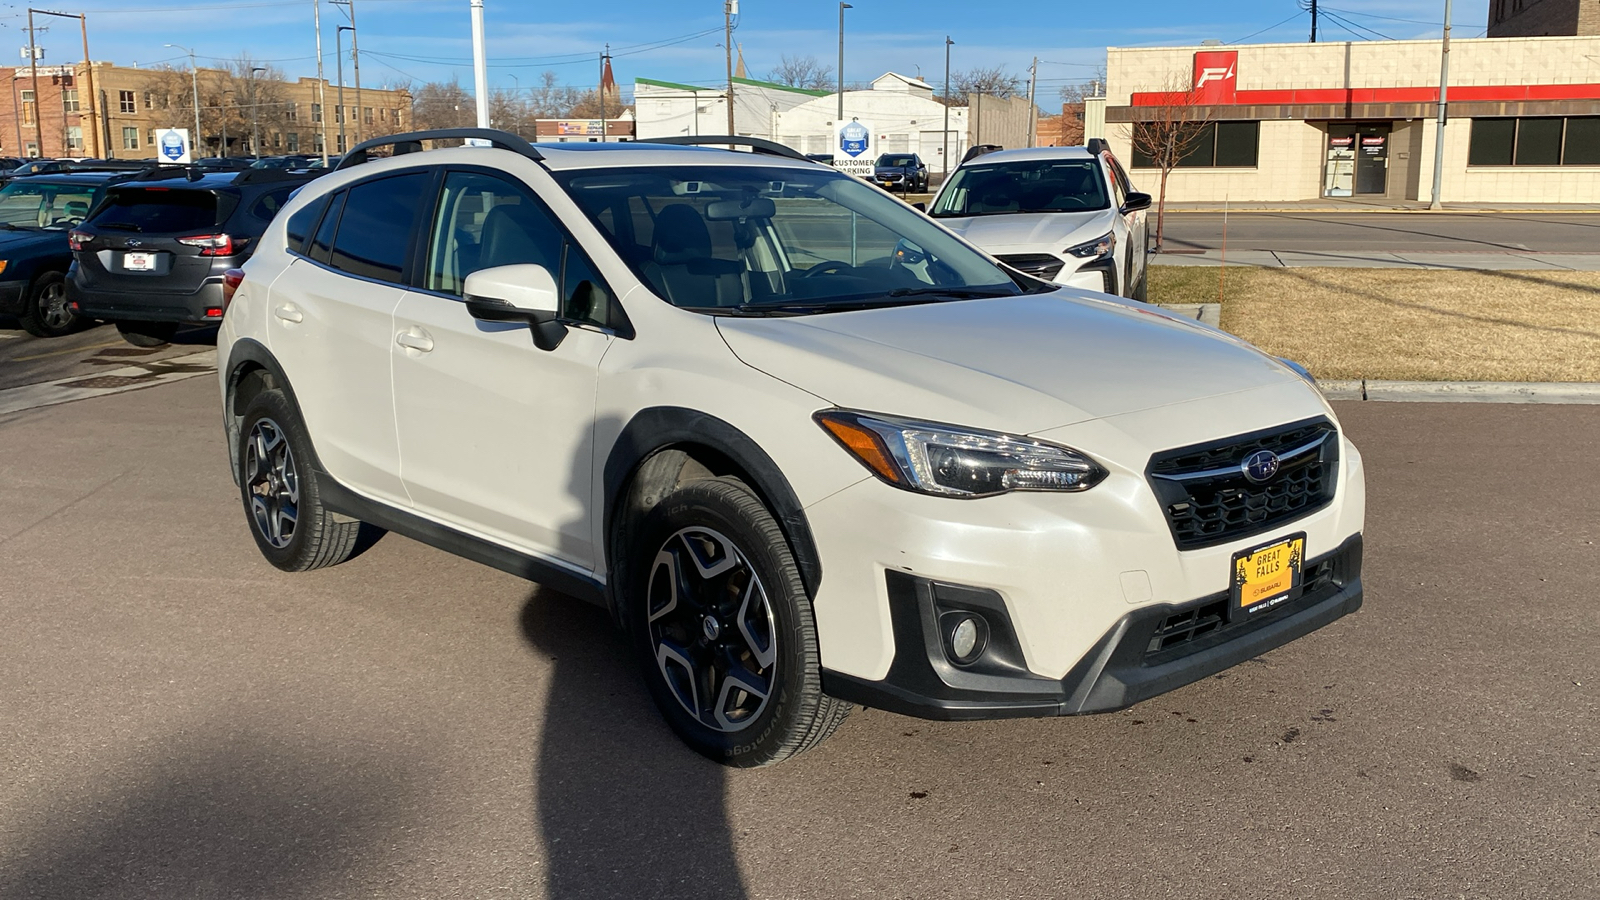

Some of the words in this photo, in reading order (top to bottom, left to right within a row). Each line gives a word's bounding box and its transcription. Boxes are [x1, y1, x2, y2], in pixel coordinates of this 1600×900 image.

[1257, 549, 1281, 566] GREAT
[1256, 561, 1280, 578] FALLS
[1260, 582, 1281, 594] SUBARU
